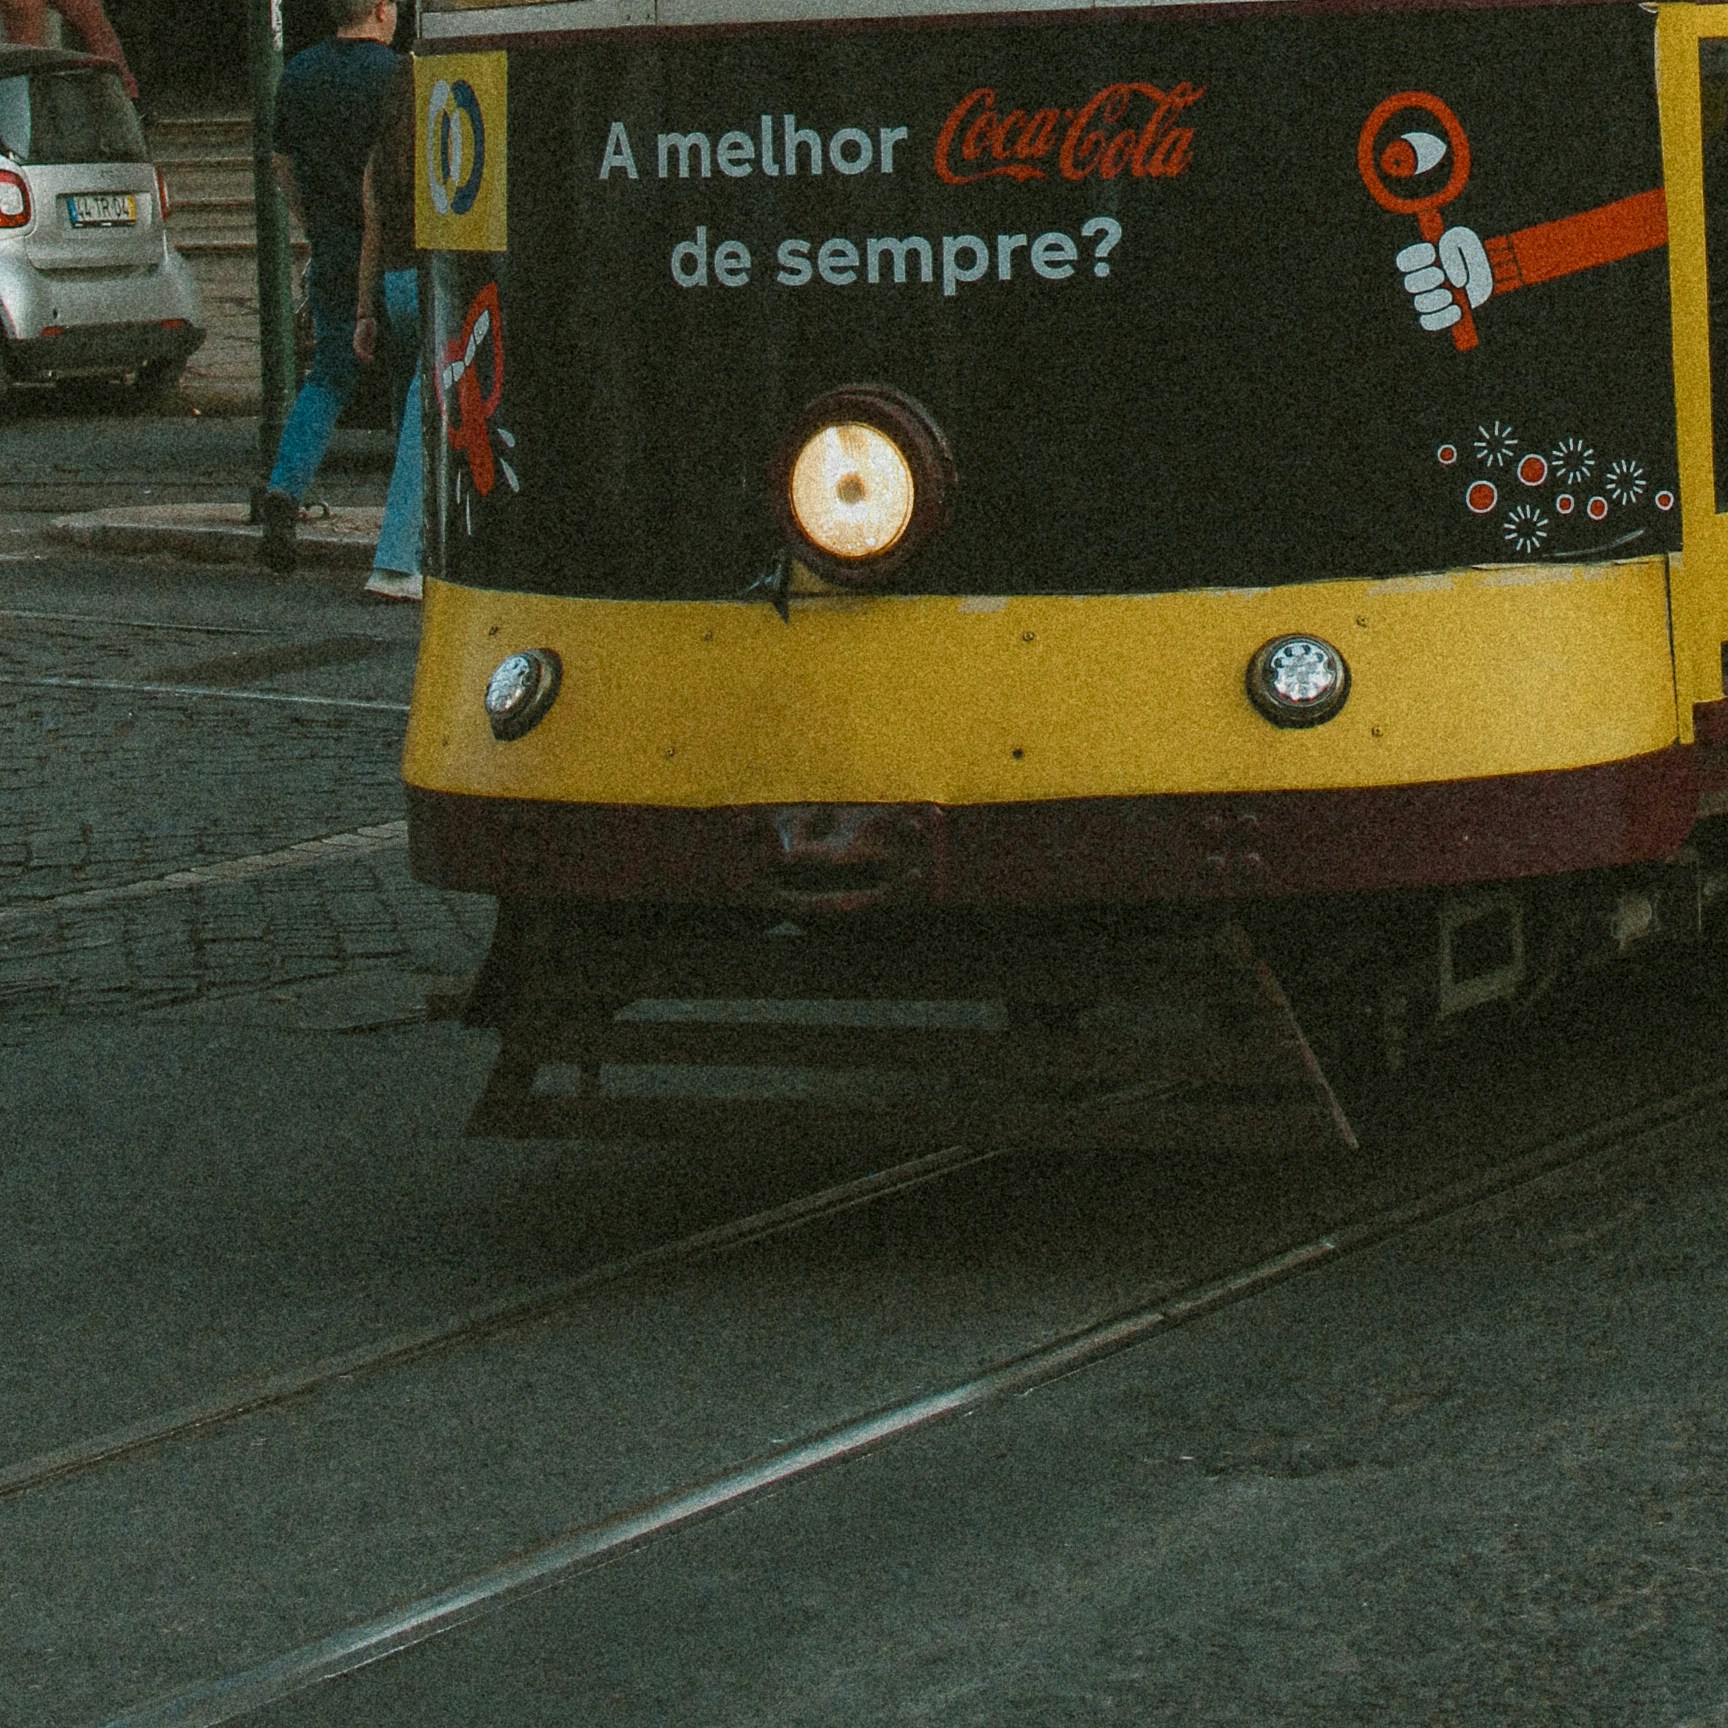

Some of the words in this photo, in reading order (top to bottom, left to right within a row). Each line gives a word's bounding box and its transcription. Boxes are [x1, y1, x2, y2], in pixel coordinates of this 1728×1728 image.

[599, 121, 638, 179] A
[657, 114, 907, 178] melhor
[934, 82, 1206, 185] Coca-Cola
[671, 225, 751, 287] de
[776, 217, 1123, 296] sempre?
